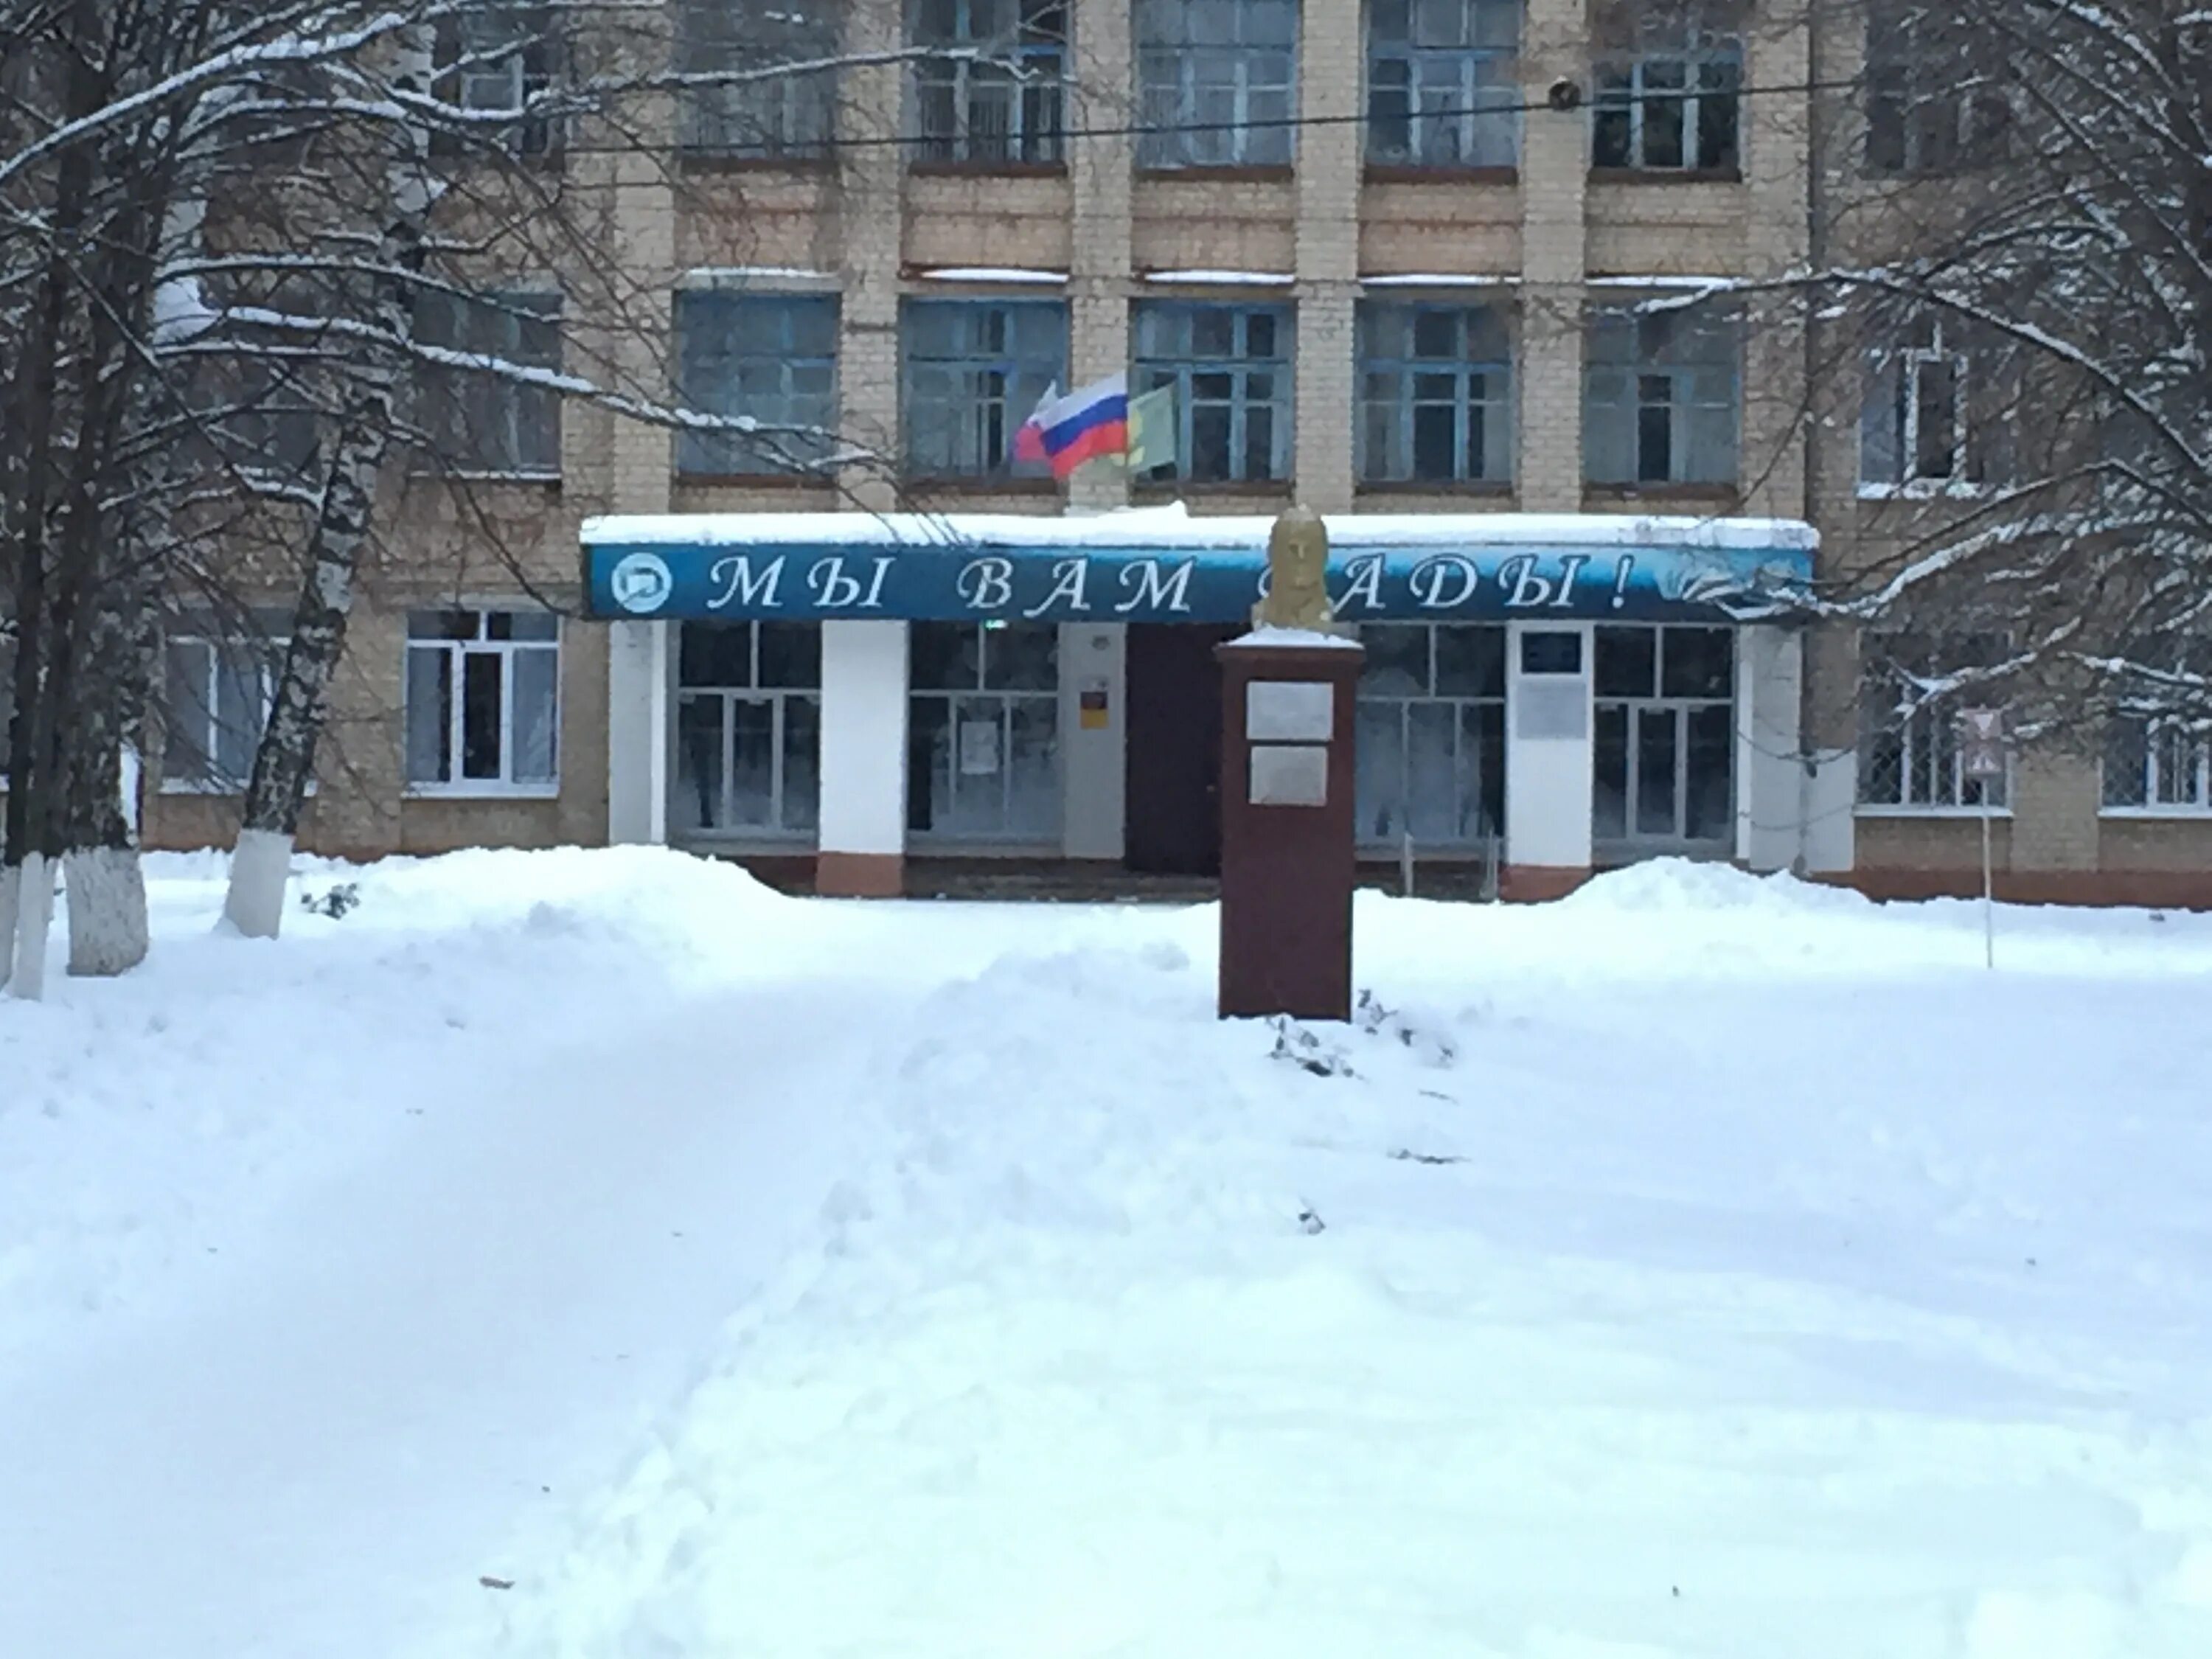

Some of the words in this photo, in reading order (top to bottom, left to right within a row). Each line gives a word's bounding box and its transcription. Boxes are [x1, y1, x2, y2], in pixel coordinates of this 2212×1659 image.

[707, 555, 894, 609] МЫ
[957, 556, 1197, 617] ВАМ
[1256, 554, 1635, 612] АДЫ!
